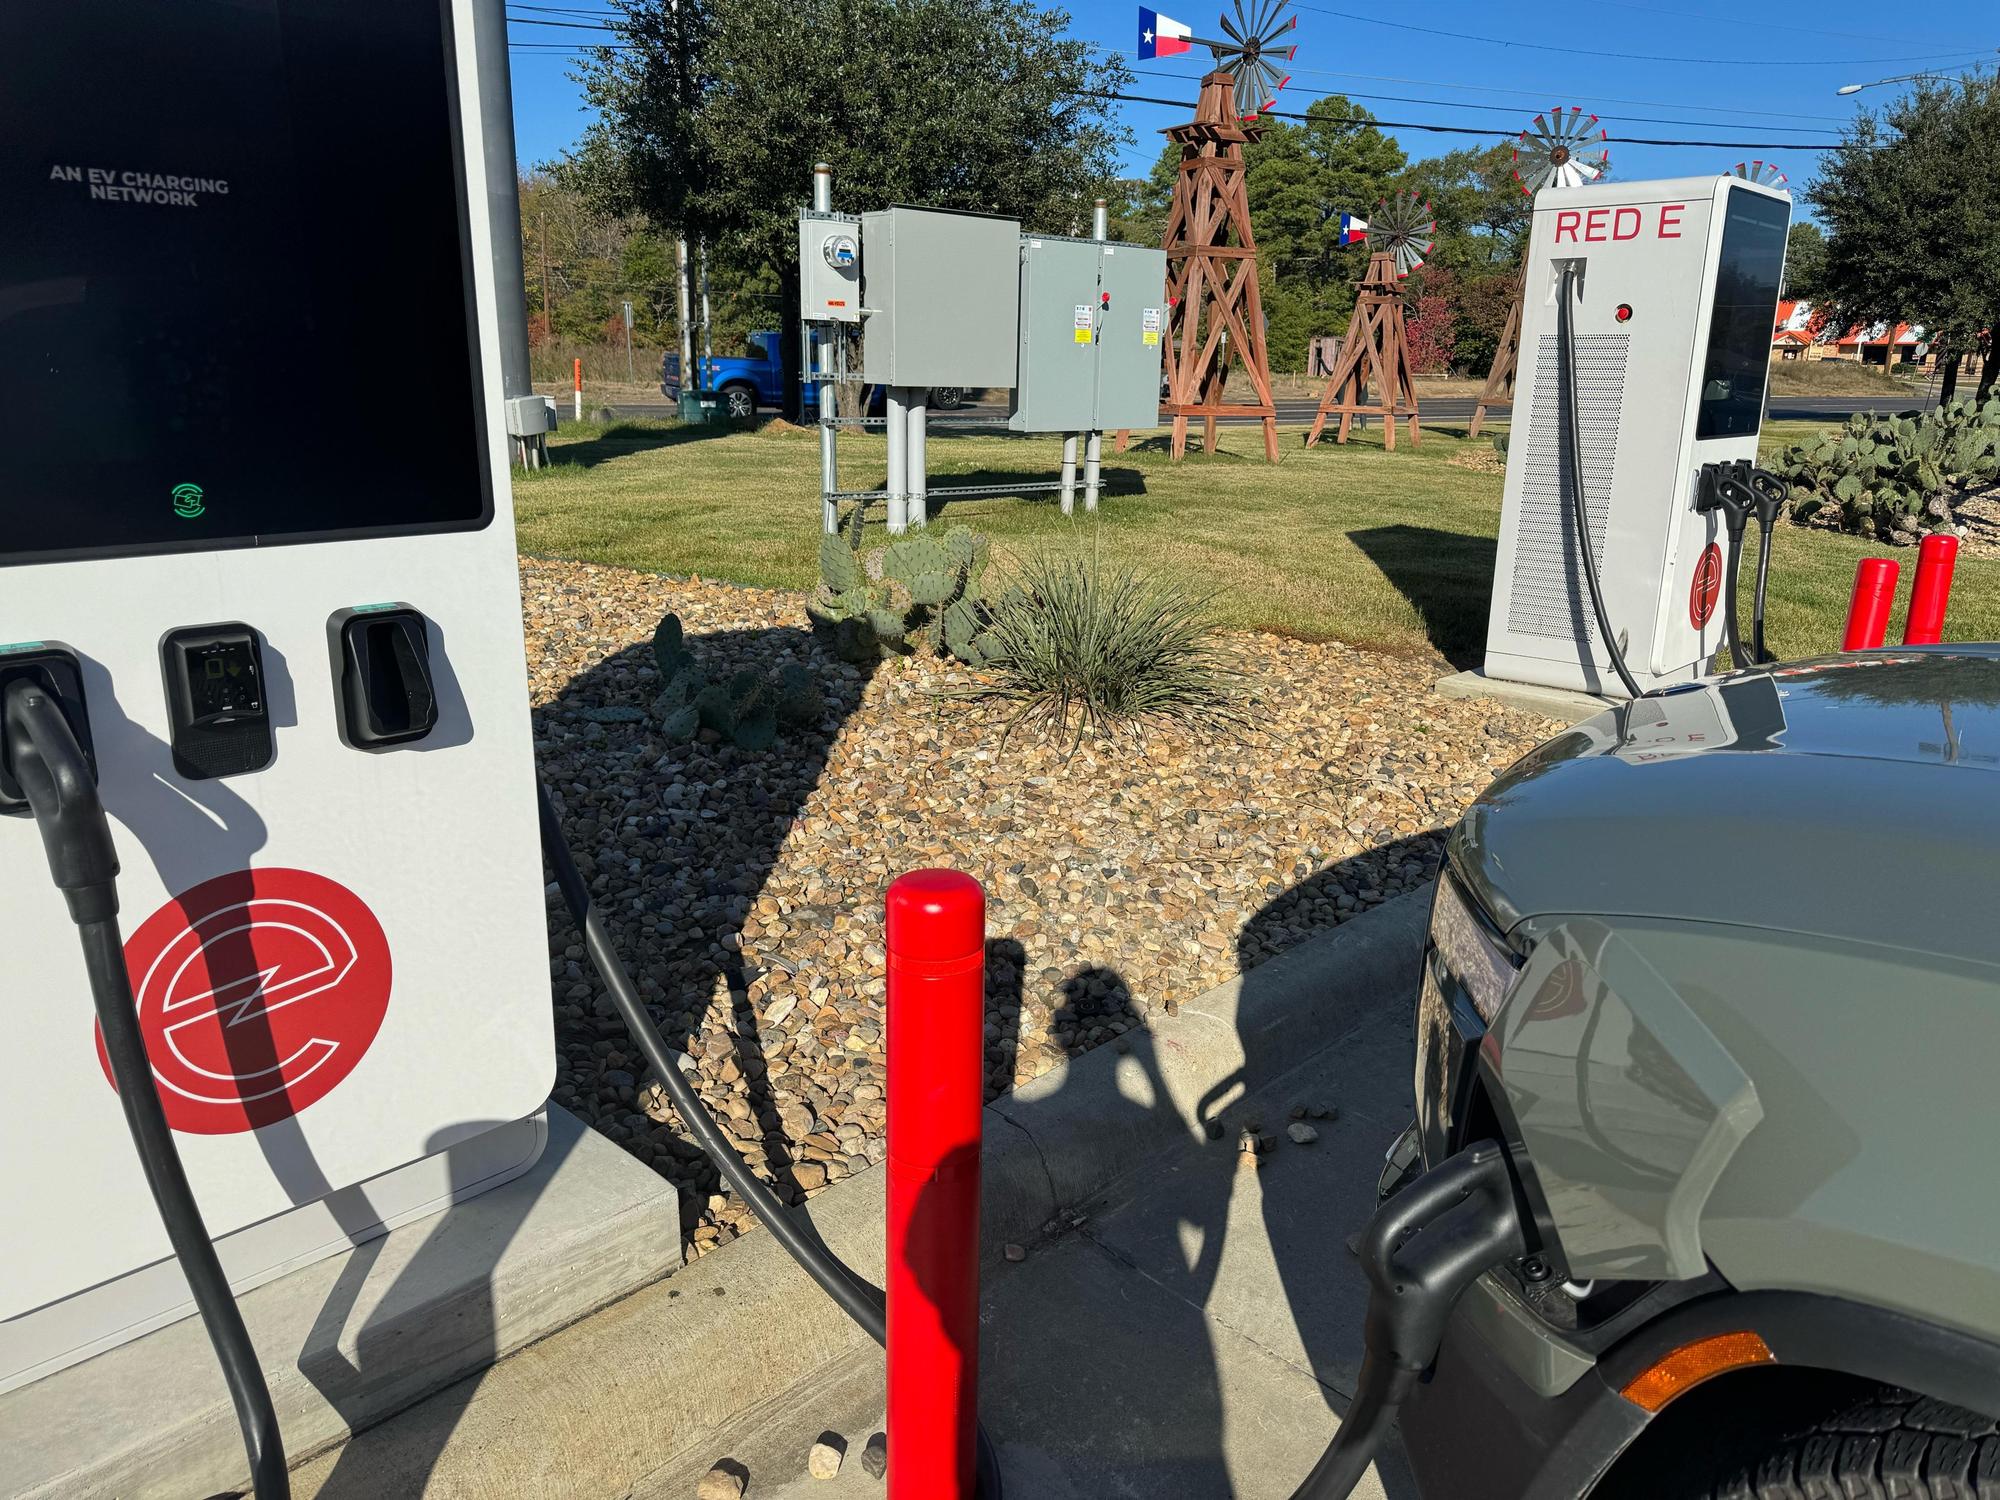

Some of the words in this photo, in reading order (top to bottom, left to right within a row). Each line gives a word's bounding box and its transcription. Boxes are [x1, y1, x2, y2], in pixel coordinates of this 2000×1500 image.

[50, 165, 82, 182] AN
[88, 168, 116, 185] EV
[121, 171, 229, 194] CHARGING
[90, 184, 198, 207] NETWORK
[1555, 207, 1642, 243] RED
[1657, 205, 1685, 239] E
